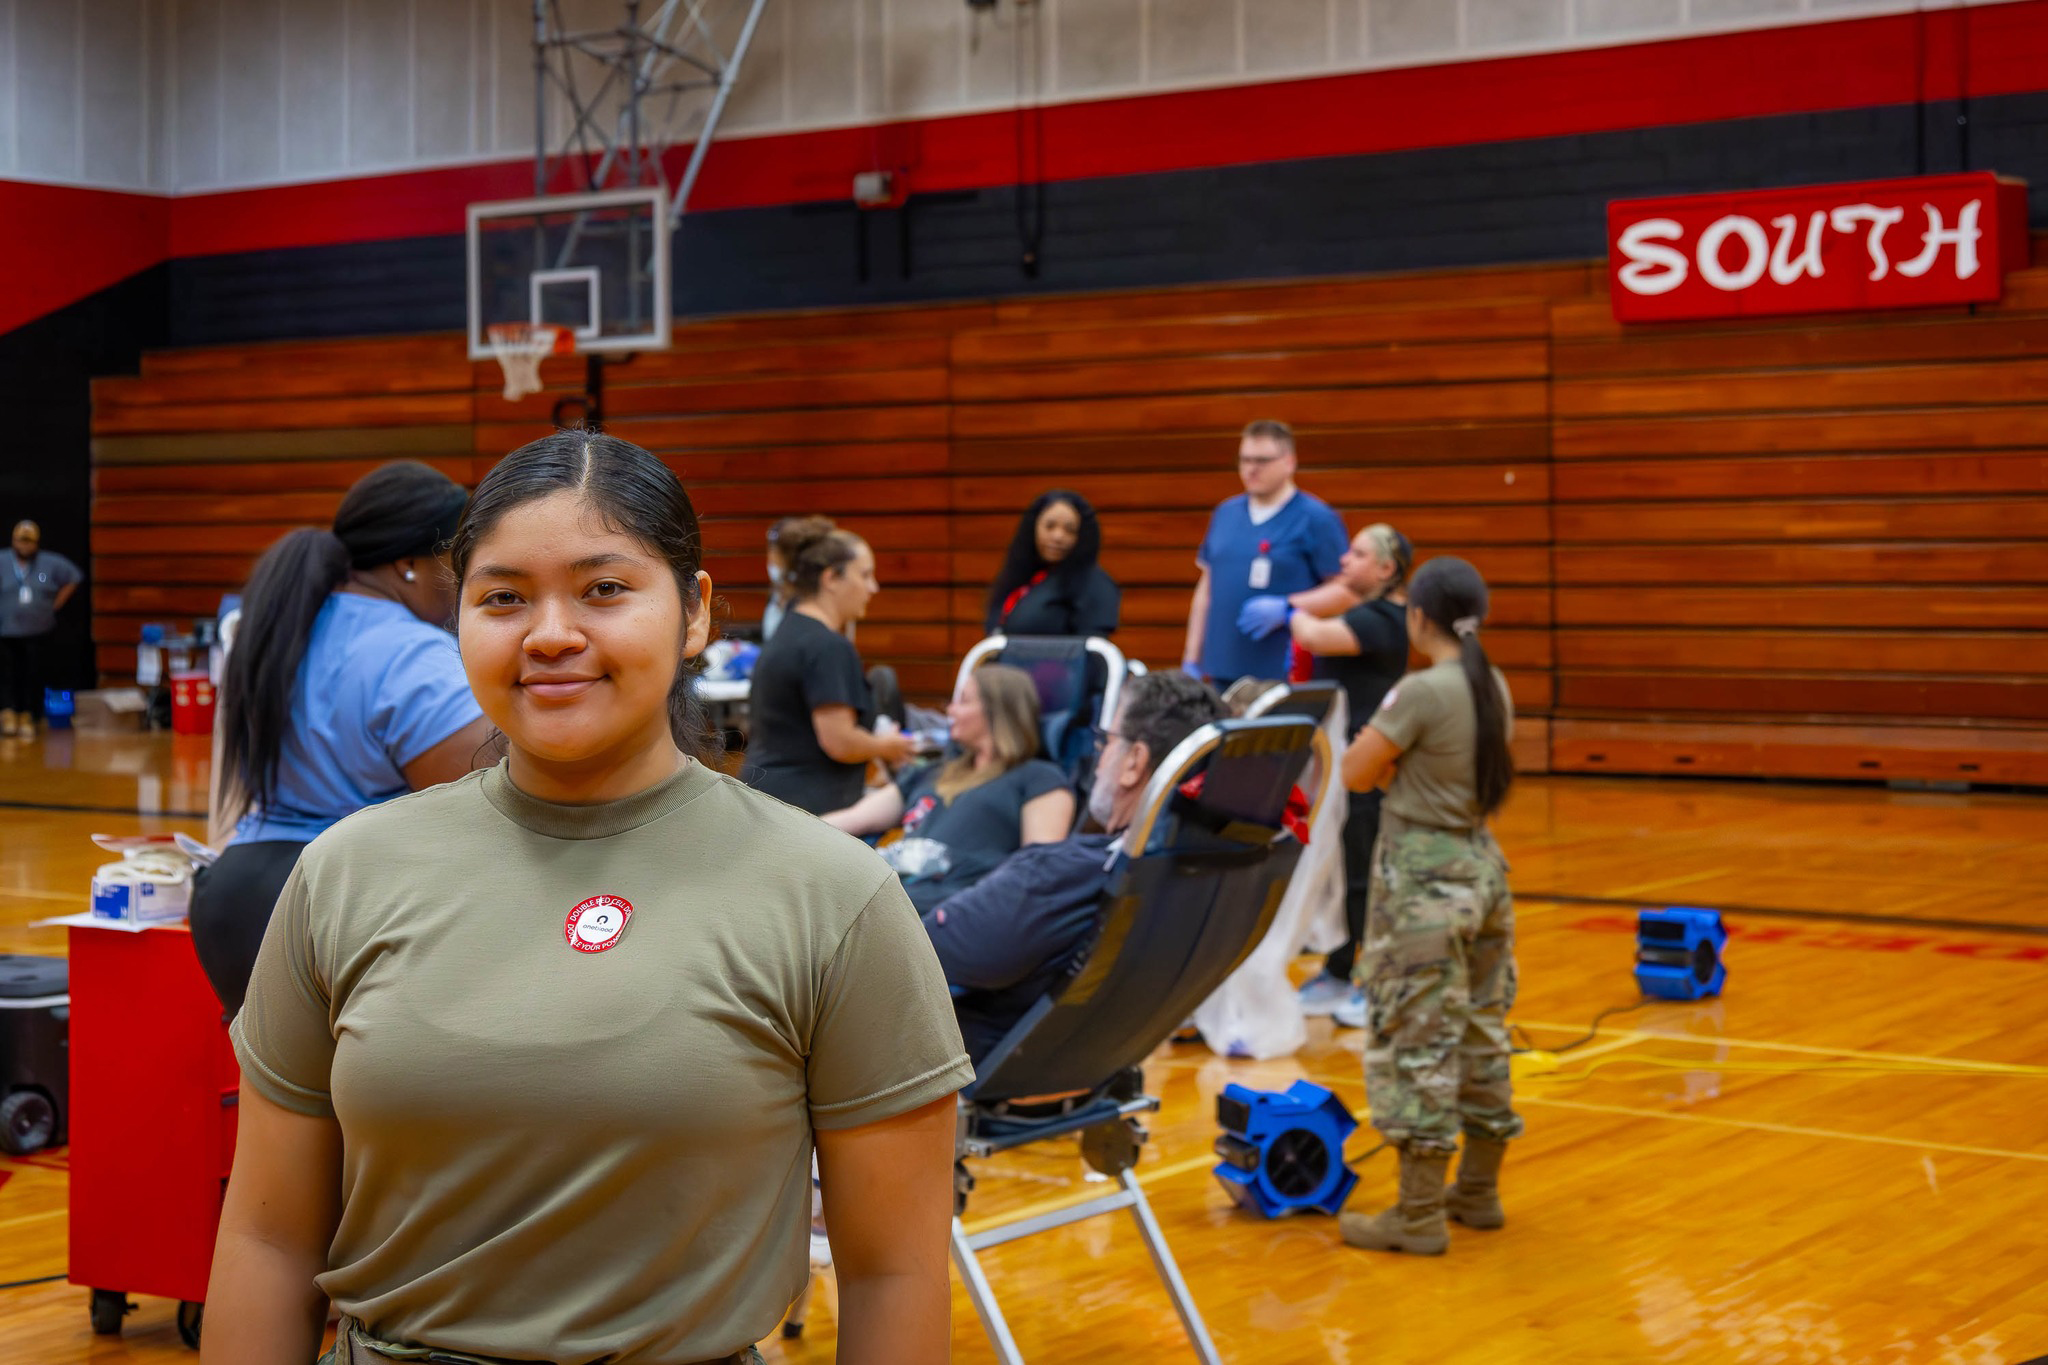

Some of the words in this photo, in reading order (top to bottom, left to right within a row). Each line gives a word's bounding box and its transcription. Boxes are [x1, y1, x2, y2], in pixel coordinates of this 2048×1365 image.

[1617, 199, 1982, 295] SOUTH
[569, 899, 595, 922] DOUBLE
[611, 898, 626, 908] CELL
[581, 943, 601, 951] YOUR
